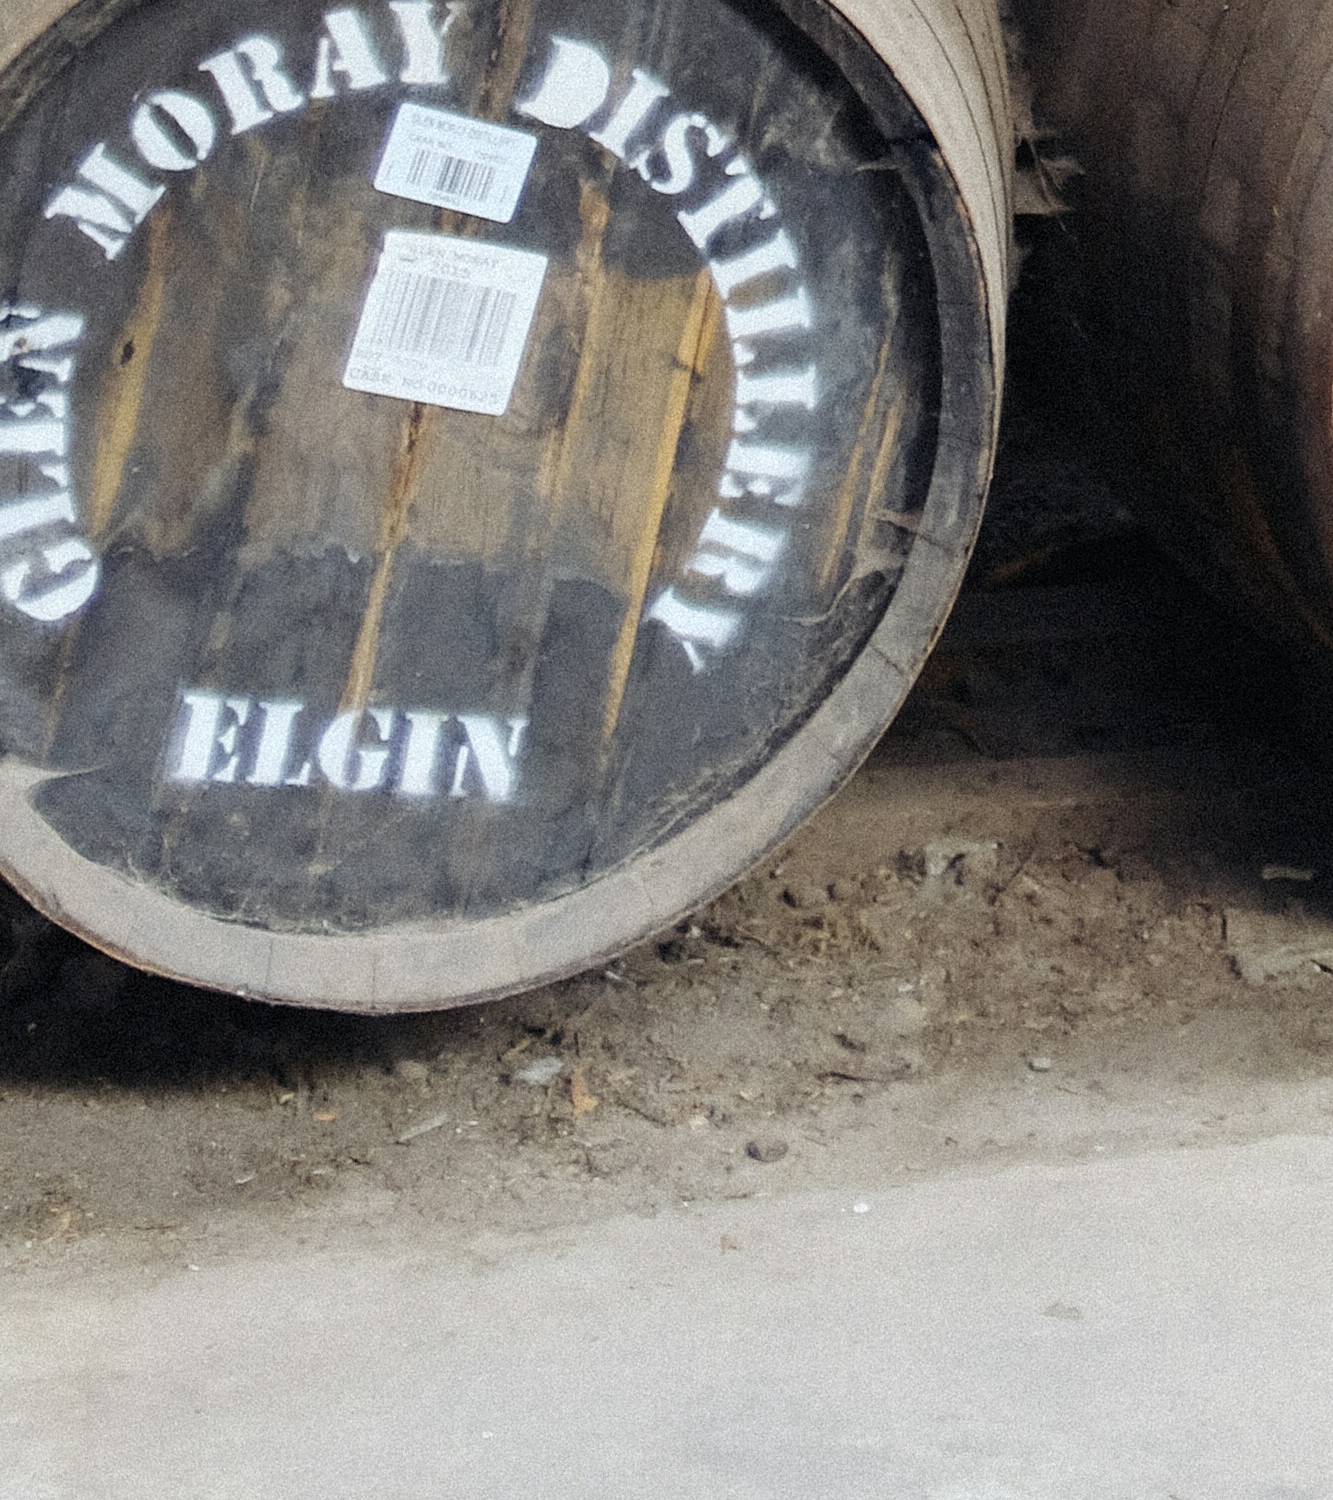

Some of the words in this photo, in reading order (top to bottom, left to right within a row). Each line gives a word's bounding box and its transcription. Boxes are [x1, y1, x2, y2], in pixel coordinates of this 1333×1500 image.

[0, 305, 101, 623] GLEN
[518, 37, 816, 674] DISTILLERY
[170, 691, 530, 803] ELGIN
